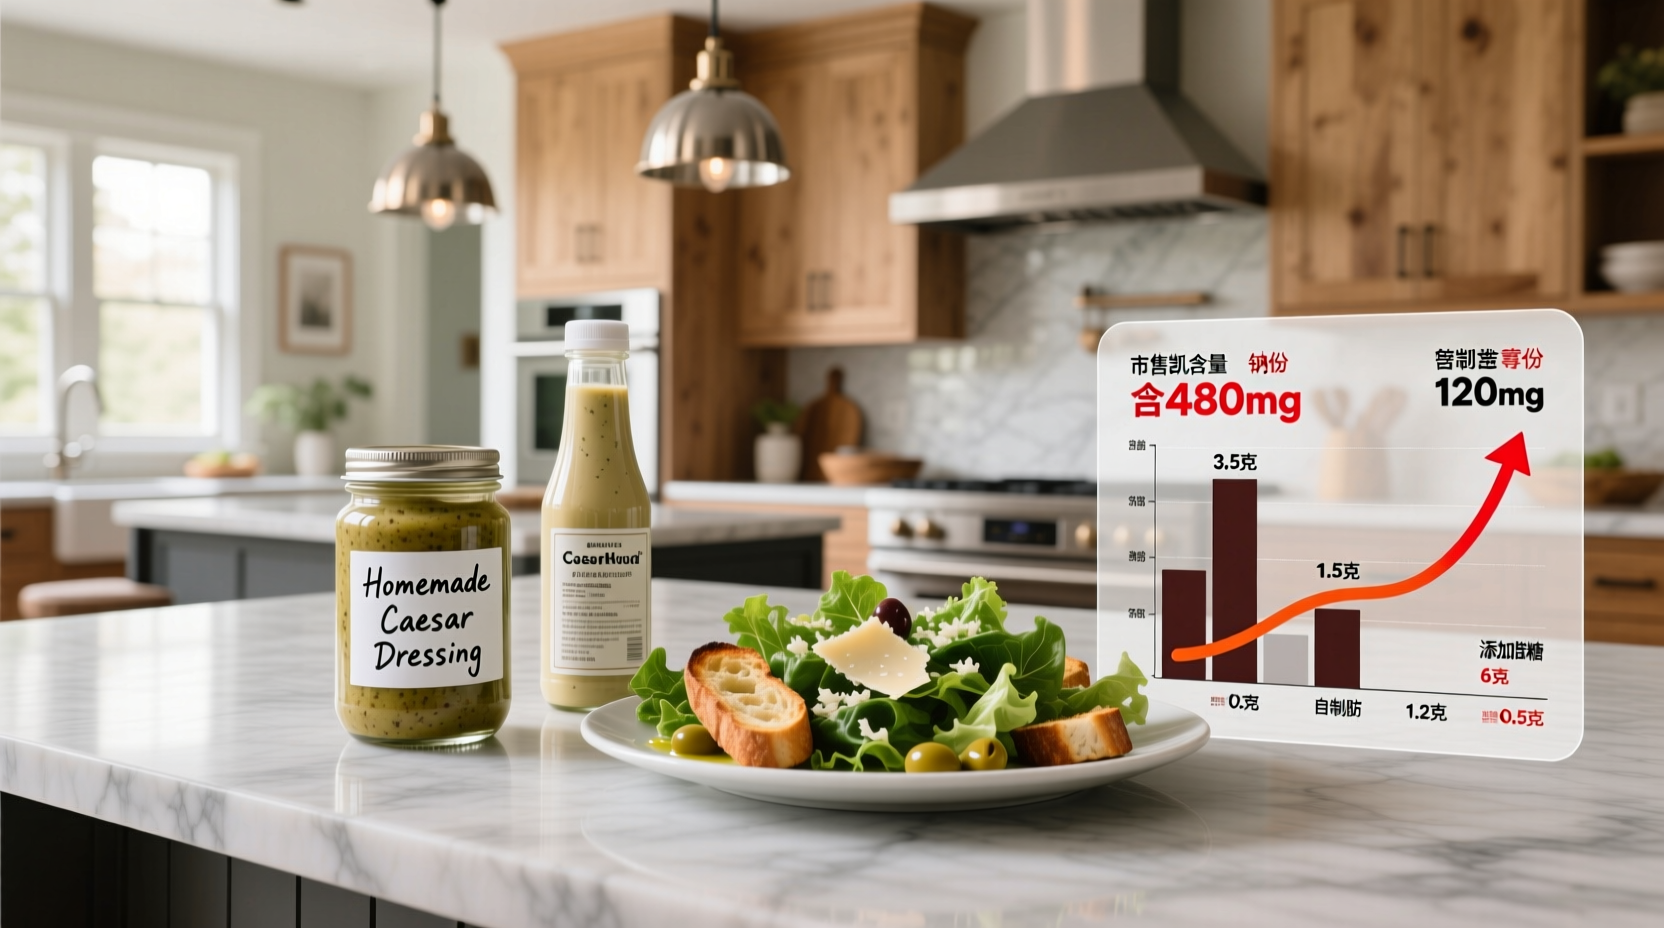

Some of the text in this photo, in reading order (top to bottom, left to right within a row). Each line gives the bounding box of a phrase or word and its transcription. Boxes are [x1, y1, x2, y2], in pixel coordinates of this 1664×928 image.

[363, 563, 491, 599] Homemade
[381, 604, 474, 634] Caesar
[374, 641, 482, 677] Dressing
